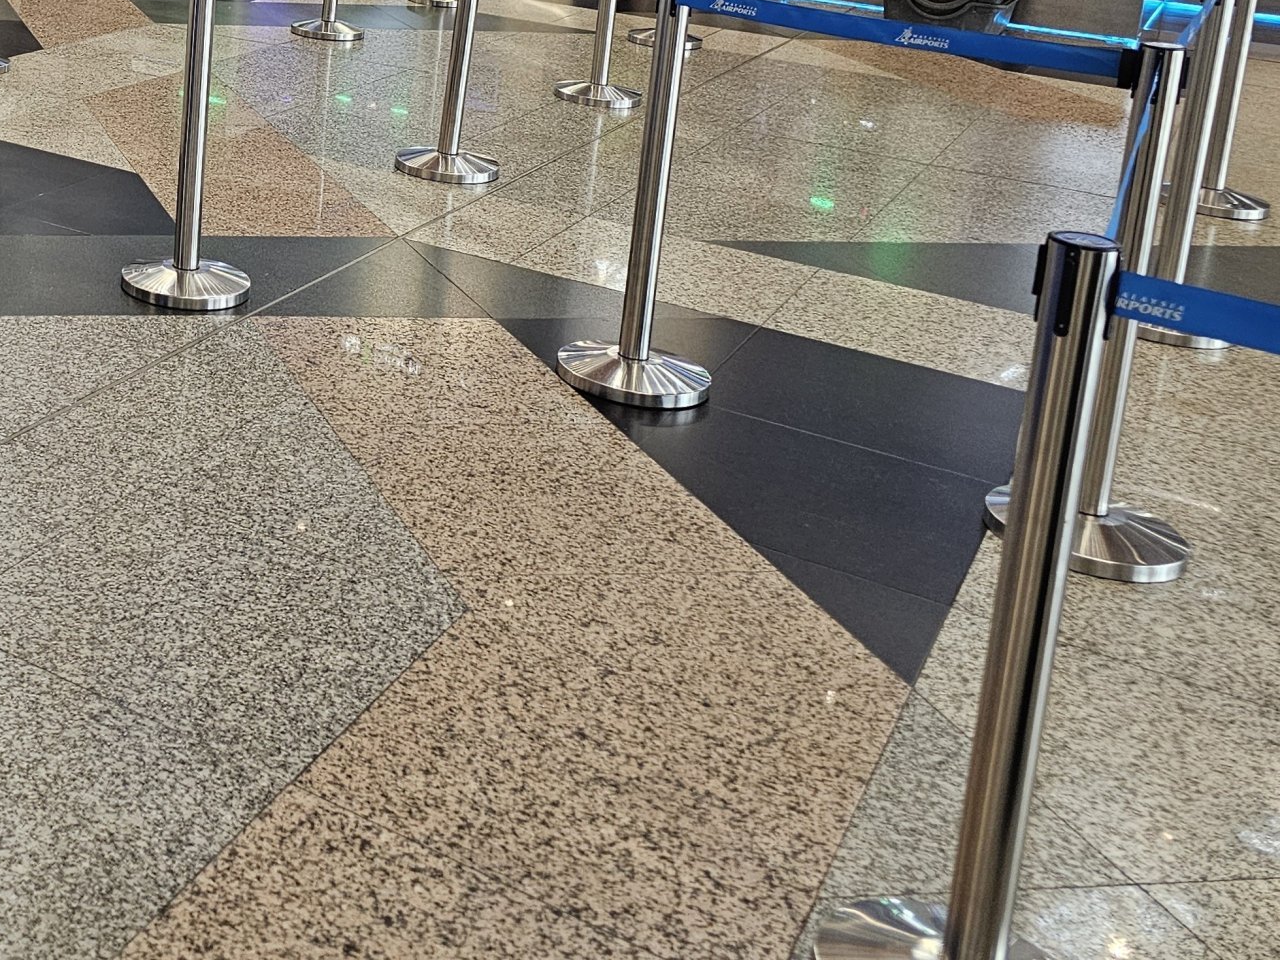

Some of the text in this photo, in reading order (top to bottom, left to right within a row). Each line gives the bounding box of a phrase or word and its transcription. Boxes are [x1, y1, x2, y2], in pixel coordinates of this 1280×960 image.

[721, 5, 756, 16] AIRPORTS
[909, 38, 948, 49] AIRPORTS
[1116, 296, 1183, 321] RPORTS
[1121, 292, 1185, 311] ALAYSIA
